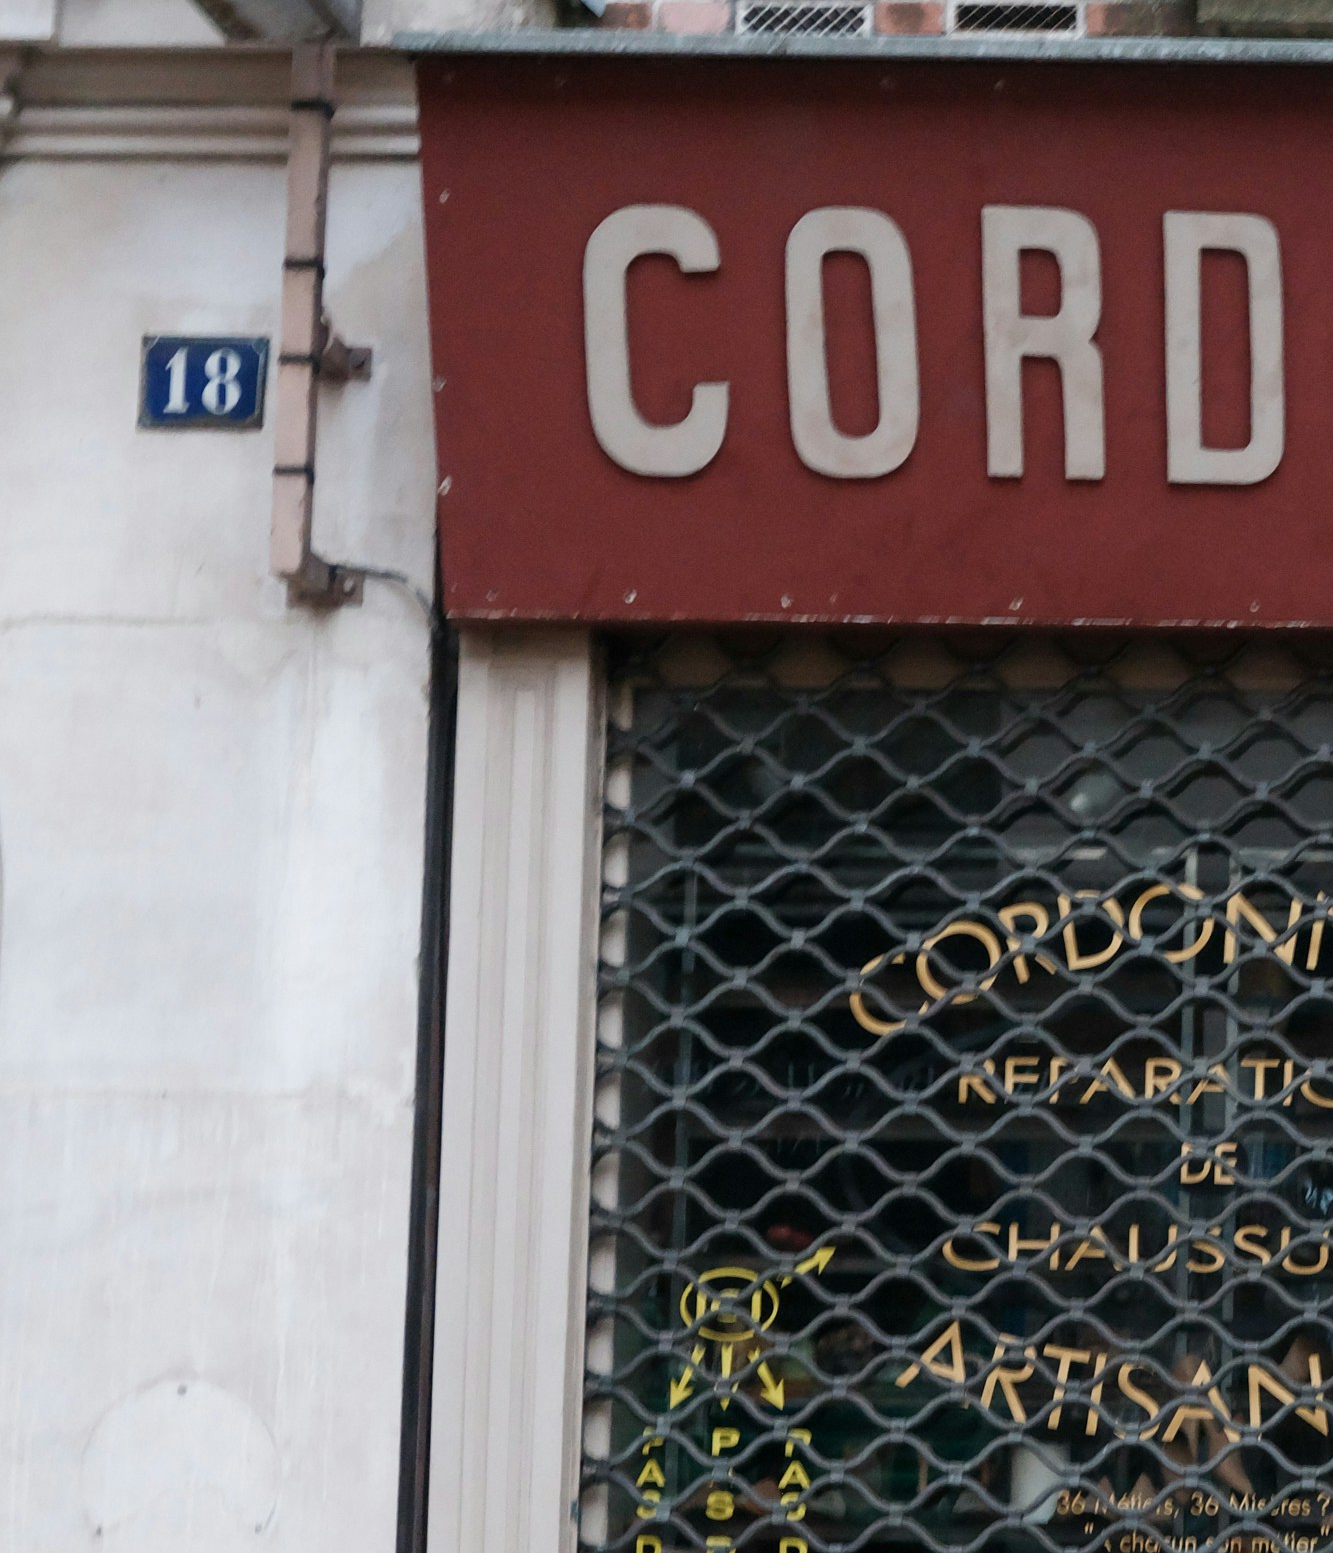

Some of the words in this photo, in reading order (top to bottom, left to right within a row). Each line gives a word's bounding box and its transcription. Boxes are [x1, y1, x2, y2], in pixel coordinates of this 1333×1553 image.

[162, 346, 243, 417] 18
[1180, 1141, 1238, 1187] DE
[706, 1426, 742, 1522] PS
[1056, 1489, 1086, 1516] 36
[1190, 1490, 1219, 1517] 36
